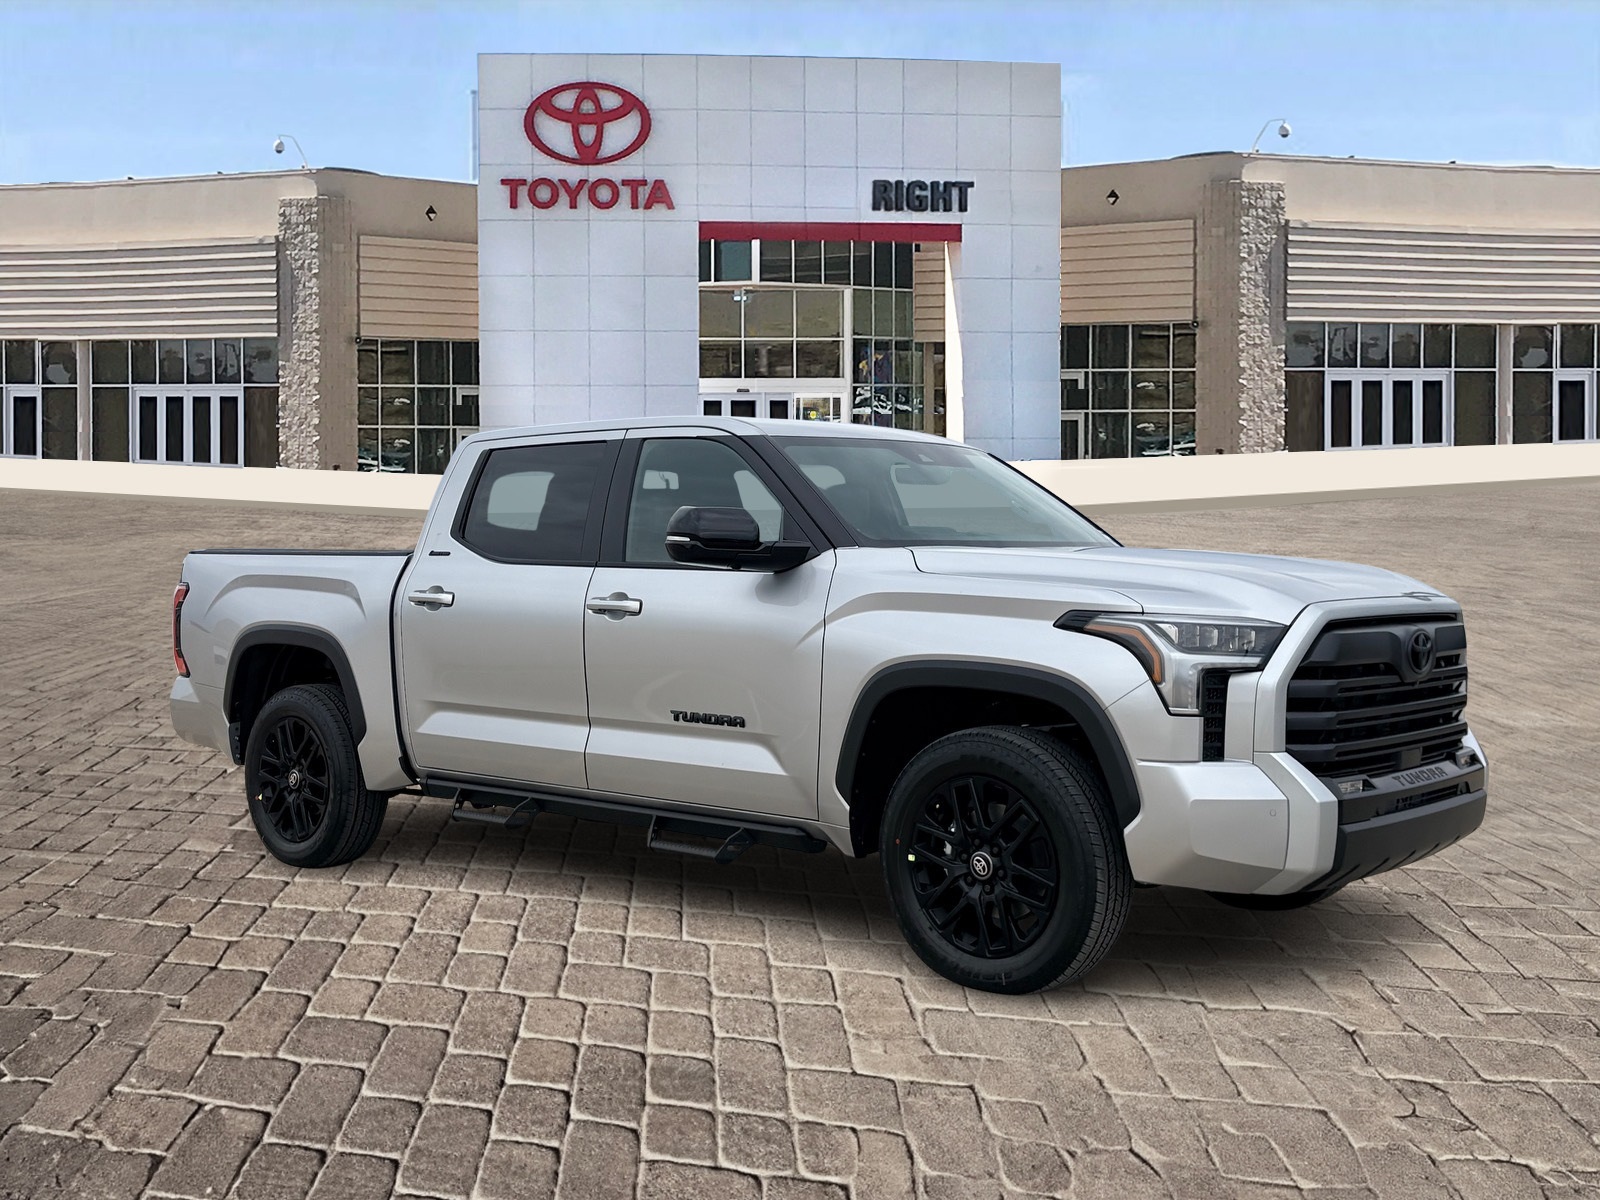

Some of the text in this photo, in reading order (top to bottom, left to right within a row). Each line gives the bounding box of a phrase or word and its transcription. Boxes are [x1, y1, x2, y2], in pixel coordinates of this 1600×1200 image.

[500, 177, 675, 210] TOYOTA
[872, 179, 975, 212] RIGHT
[670, 710, 746, 728] TUNDRA
[1392, 766, 1448, 787] TUNDRA
